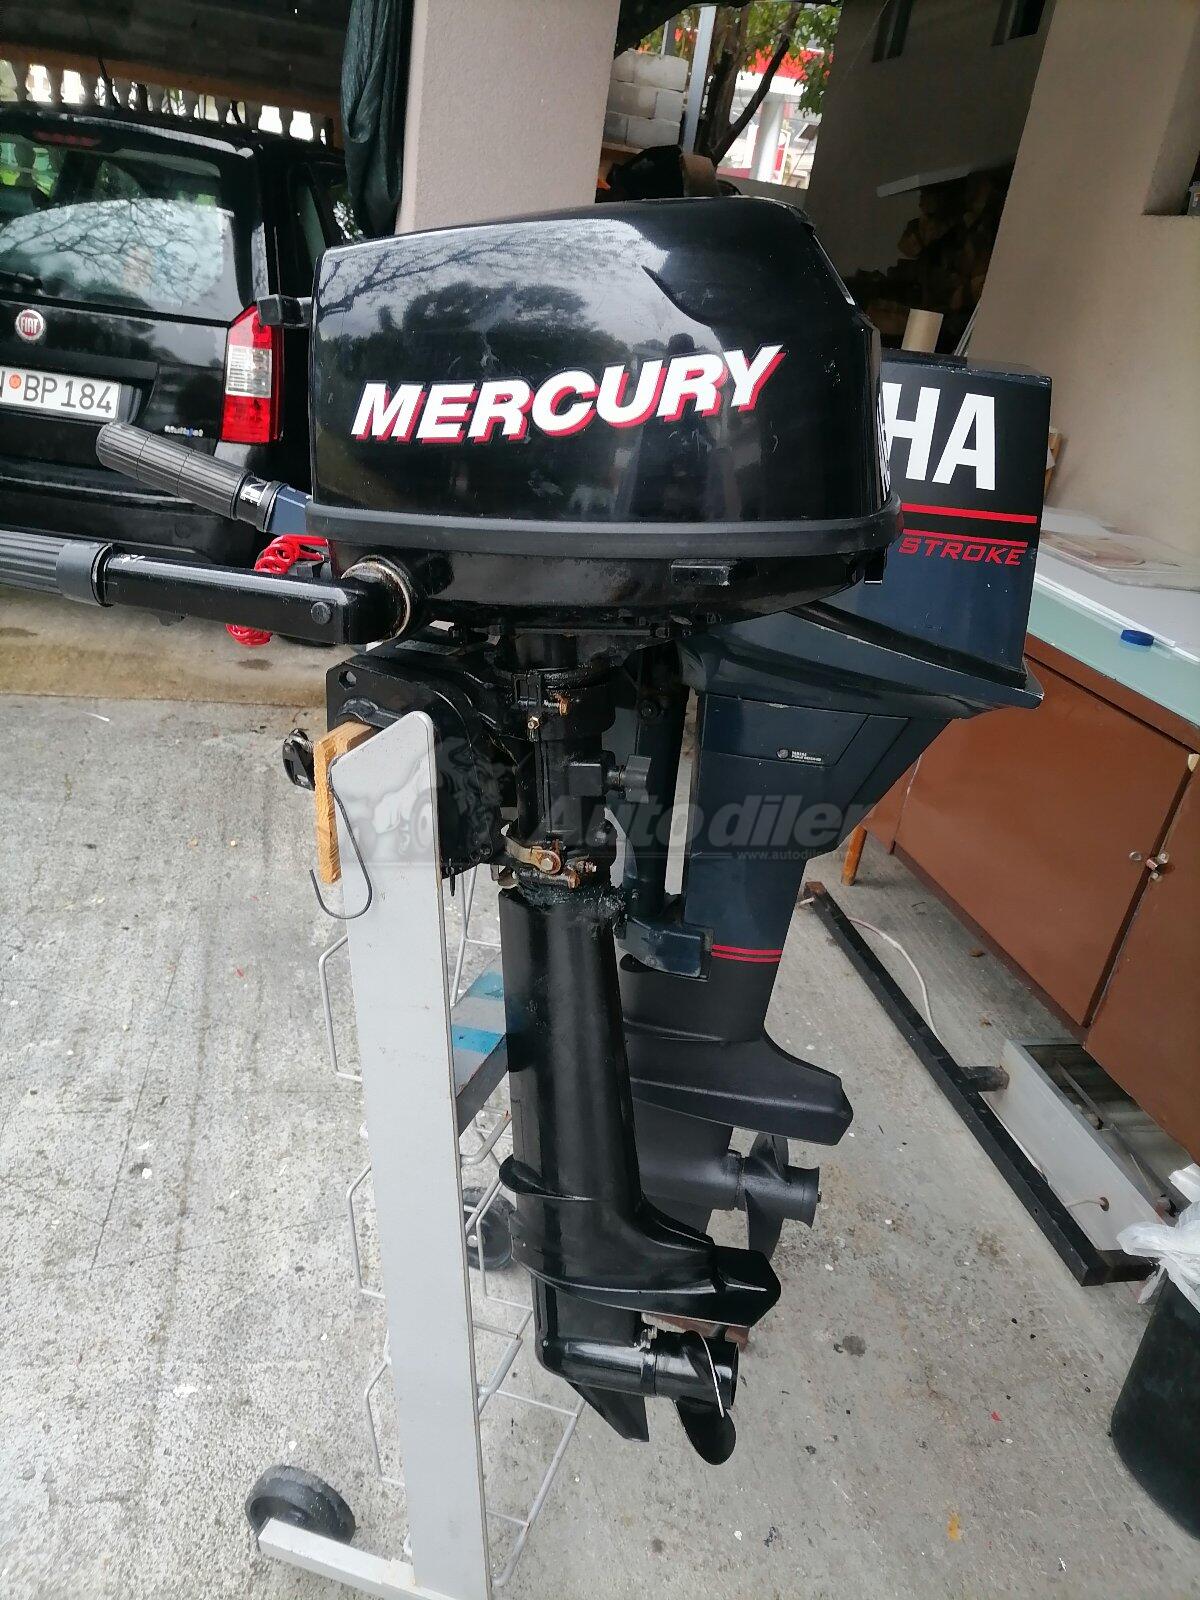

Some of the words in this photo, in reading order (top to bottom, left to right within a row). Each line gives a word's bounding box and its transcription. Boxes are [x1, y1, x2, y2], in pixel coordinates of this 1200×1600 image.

[20, 316, 40, 334] FIAT
[350, 343, 787, 444] MERCURY
[899, 537, 1028, 566] STROKE
